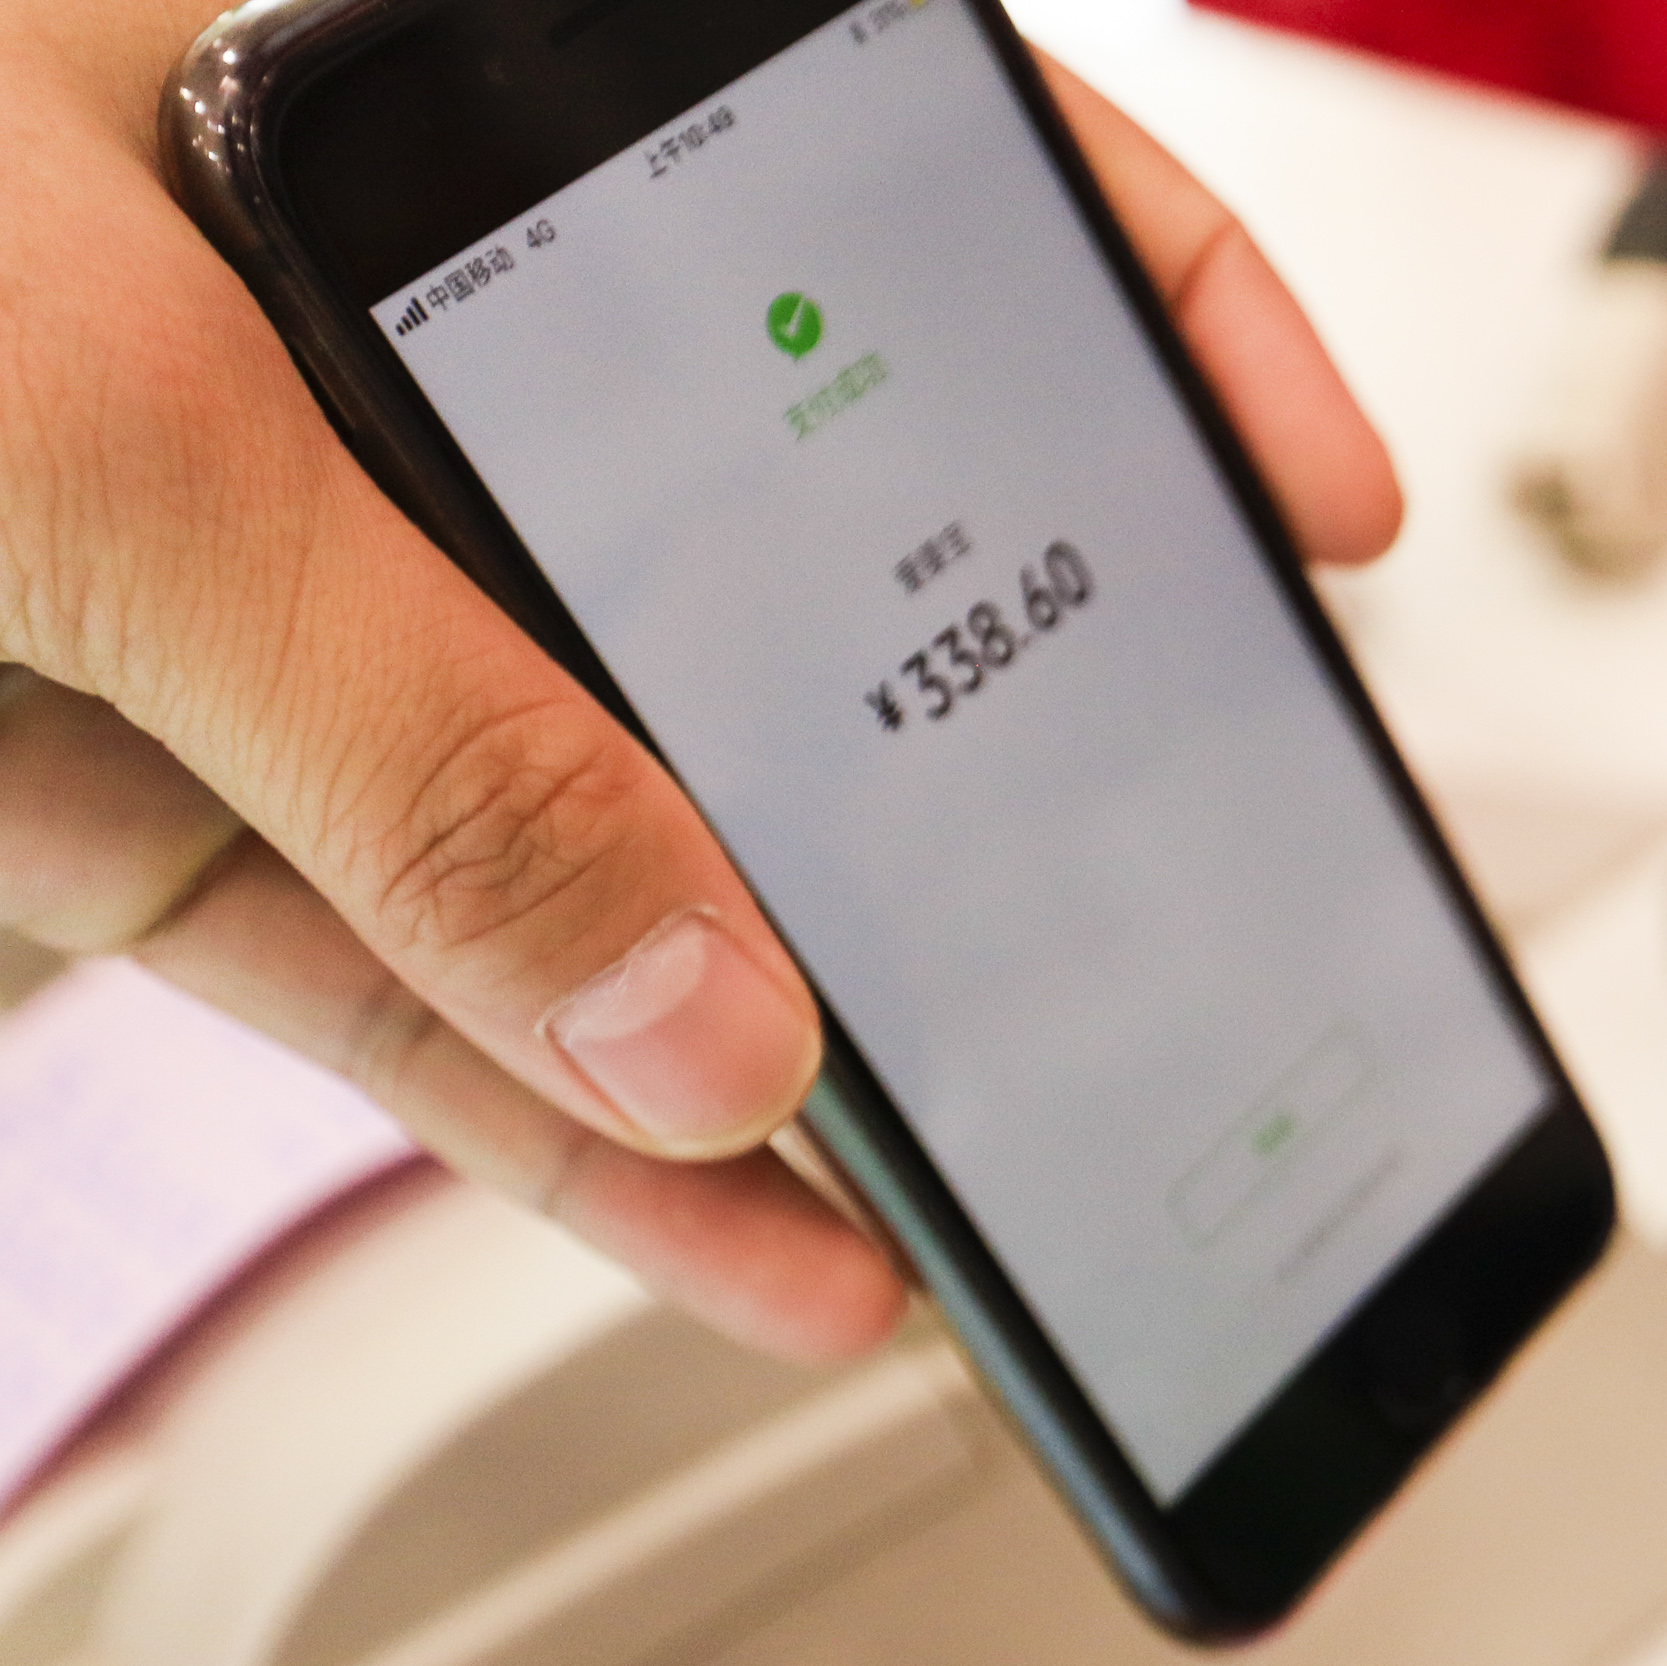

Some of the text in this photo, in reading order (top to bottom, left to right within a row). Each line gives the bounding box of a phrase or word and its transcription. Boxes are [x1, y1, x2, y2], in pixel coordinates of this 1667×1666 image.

[426, 219, 557, 314] 中国移动 4G
